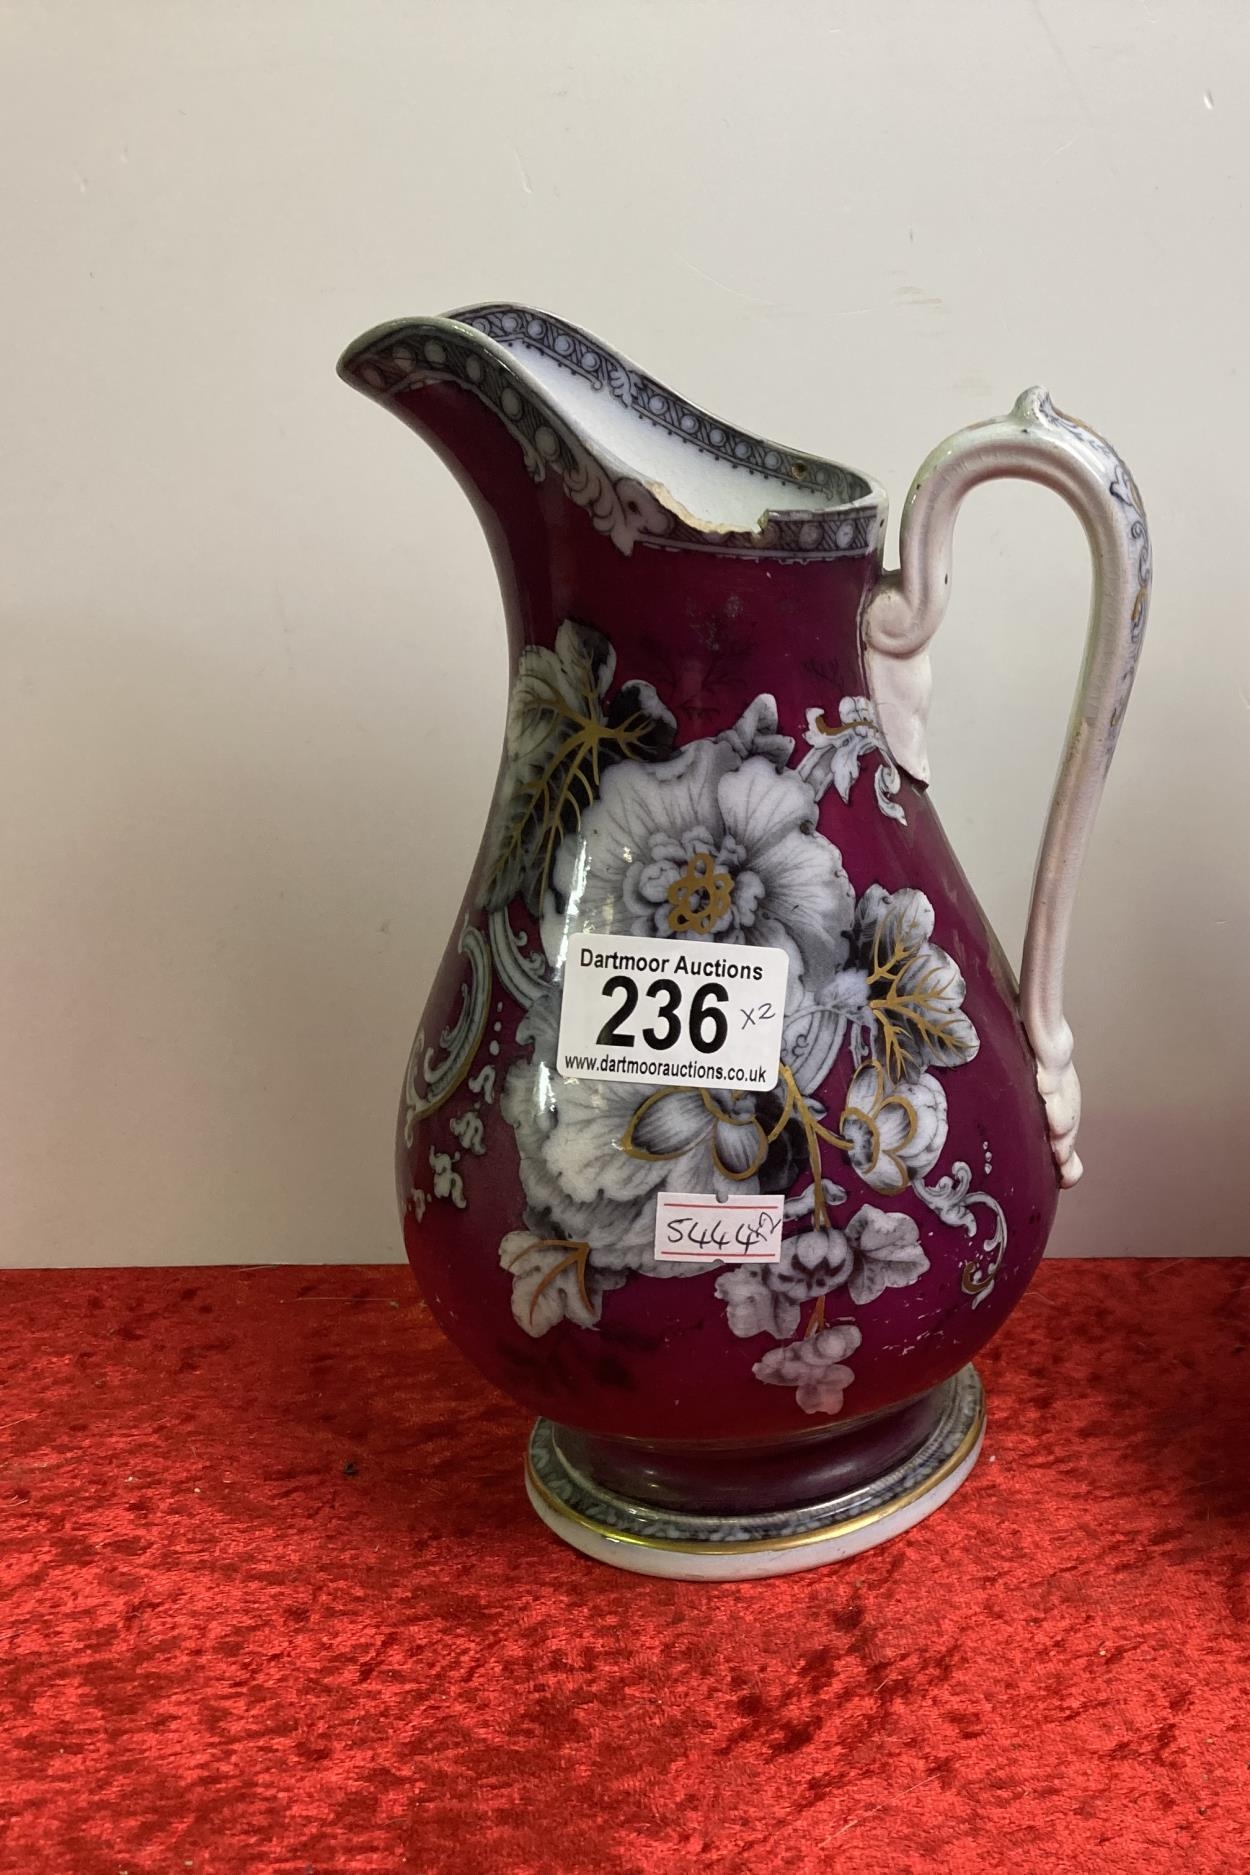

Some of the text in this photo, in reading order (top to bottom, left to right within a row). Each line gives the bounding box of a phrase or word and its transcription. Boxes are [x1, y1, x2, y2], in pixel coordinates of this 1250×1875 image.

[580, 948, 763, 980] Dartmoor Auctions
[596, 975, 729, 1054] 236
[565, 1054, 766, 1082] www.dartmoorauctions.co.uk
